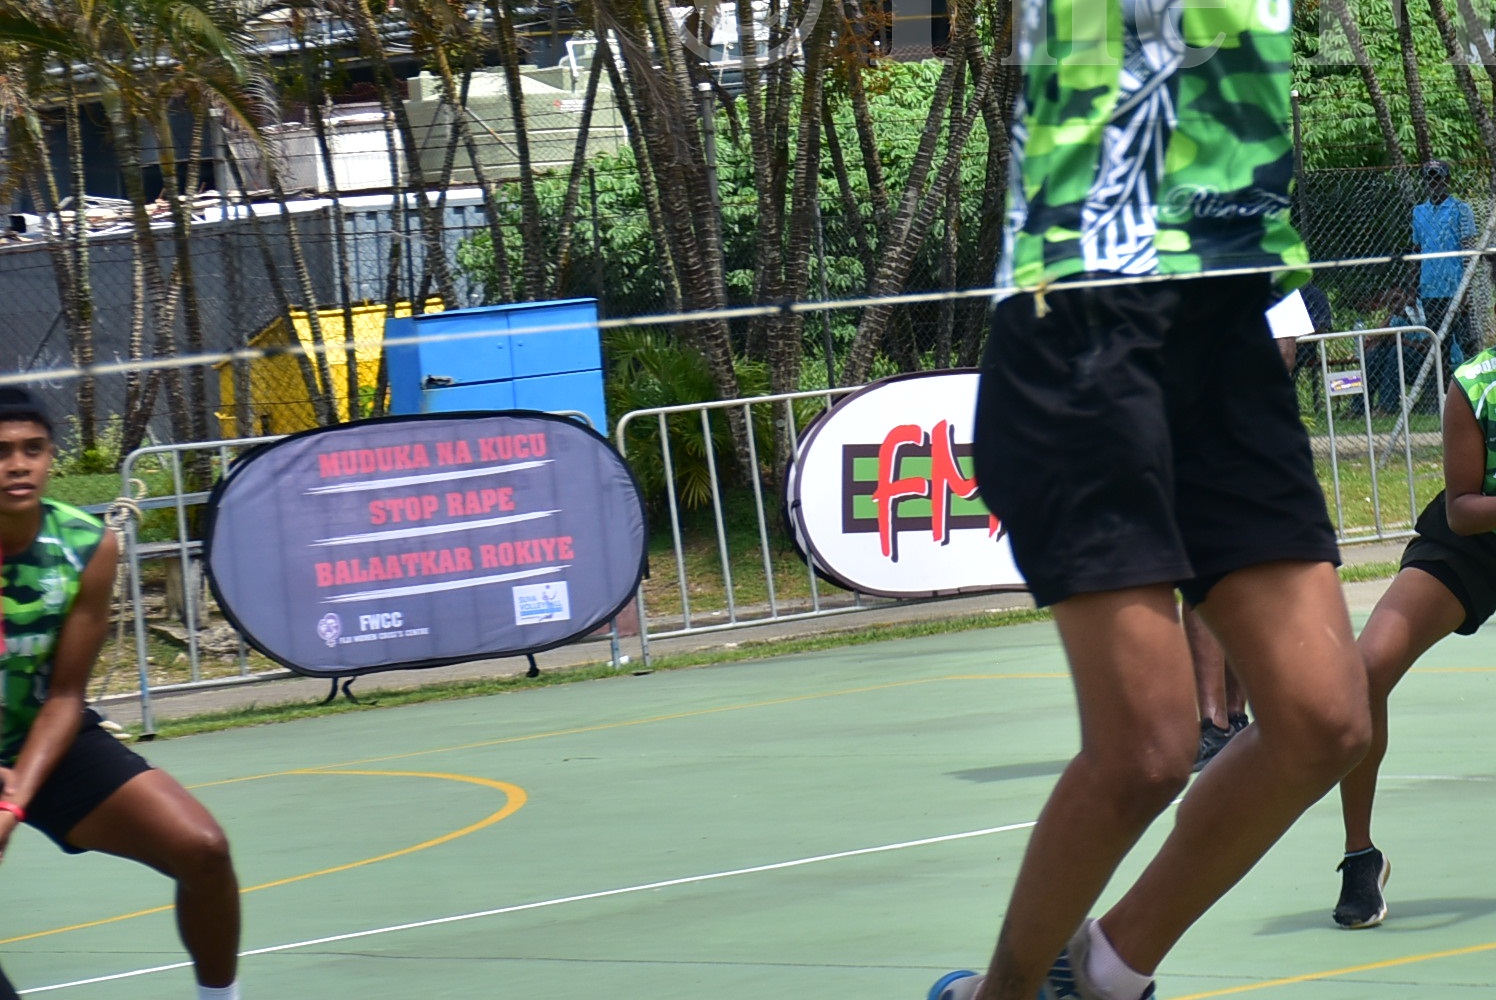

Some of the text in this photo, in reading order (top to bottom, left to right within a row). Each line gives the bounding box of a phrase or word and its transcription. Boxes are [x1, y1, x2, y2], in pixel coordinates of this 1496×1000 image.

[317, 433, 547, 478] MUDUKA NA KUCU
[369, 487, 515, 525] STOP RAPE
[315, 536, 574, 587] BALAATKAR ROKIYE
[359, 611, 404, 632] FWCC
